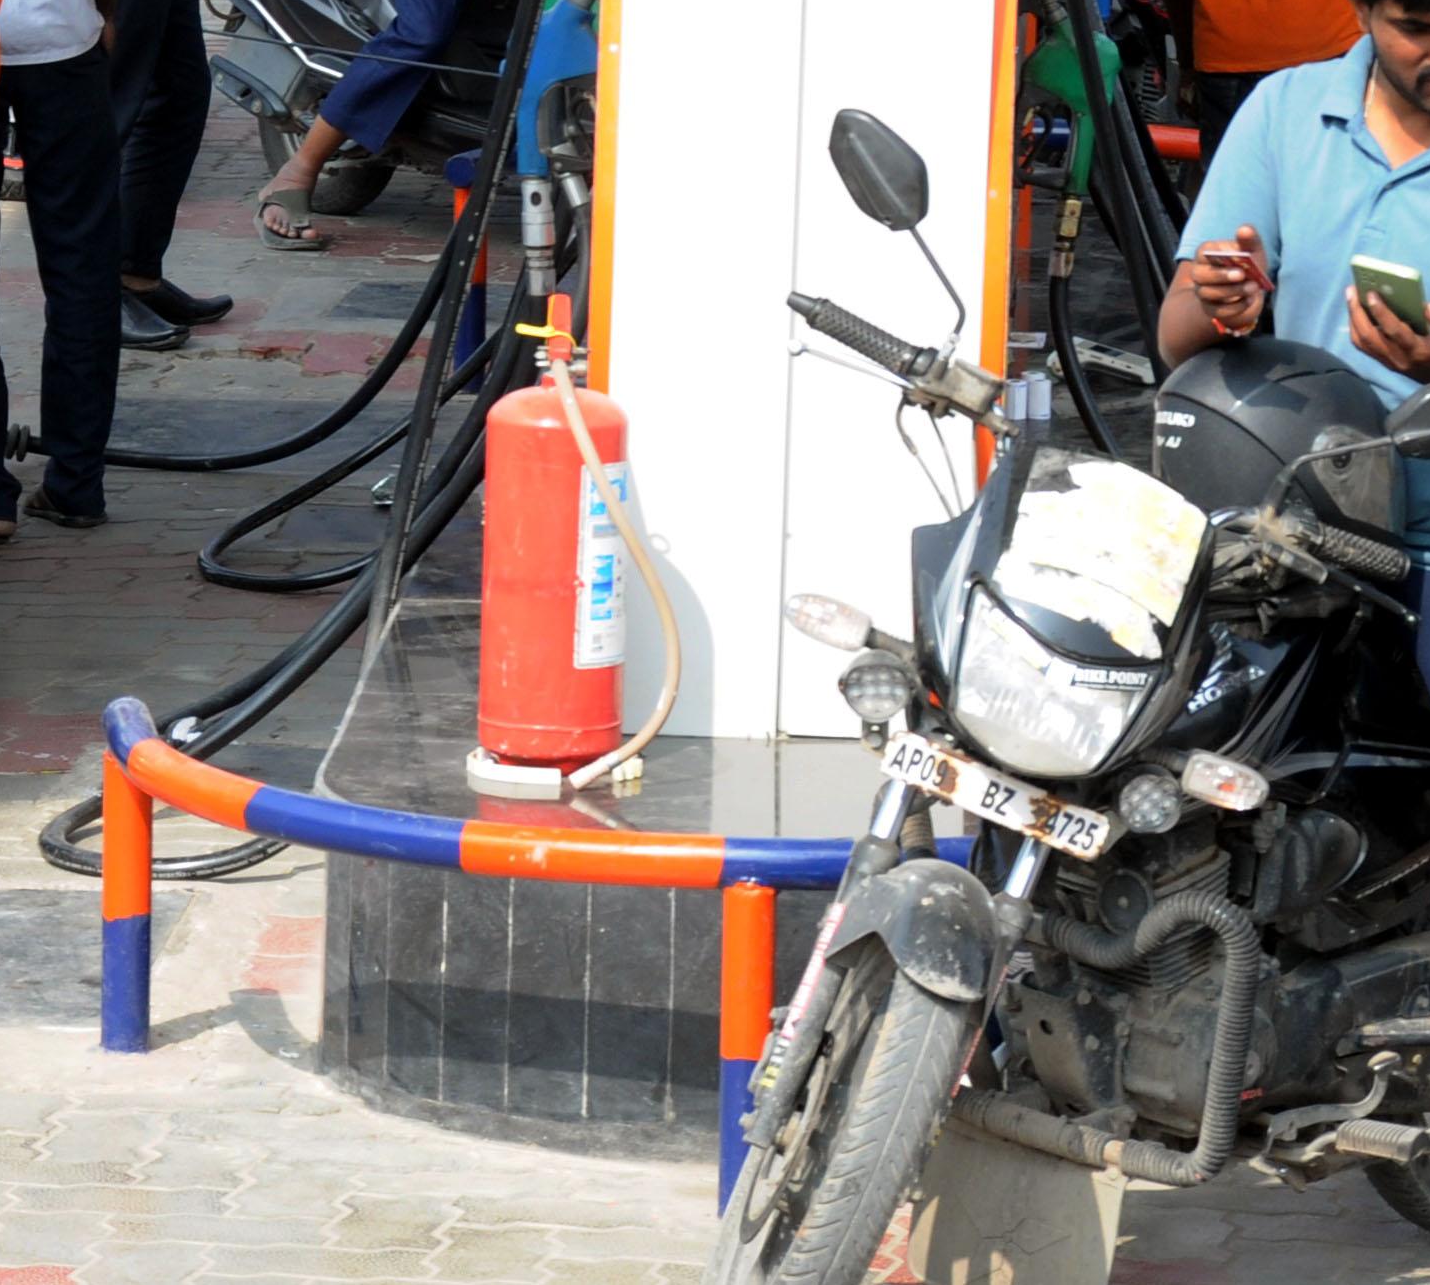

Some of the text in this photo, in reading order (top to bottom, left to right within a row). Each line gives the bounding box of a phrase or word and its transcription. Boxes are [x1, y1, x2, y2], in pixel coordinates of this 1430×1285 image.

[1075, 668, 1148, 685] BIKE POINT
[980, 780, 1016, 816] BZ
